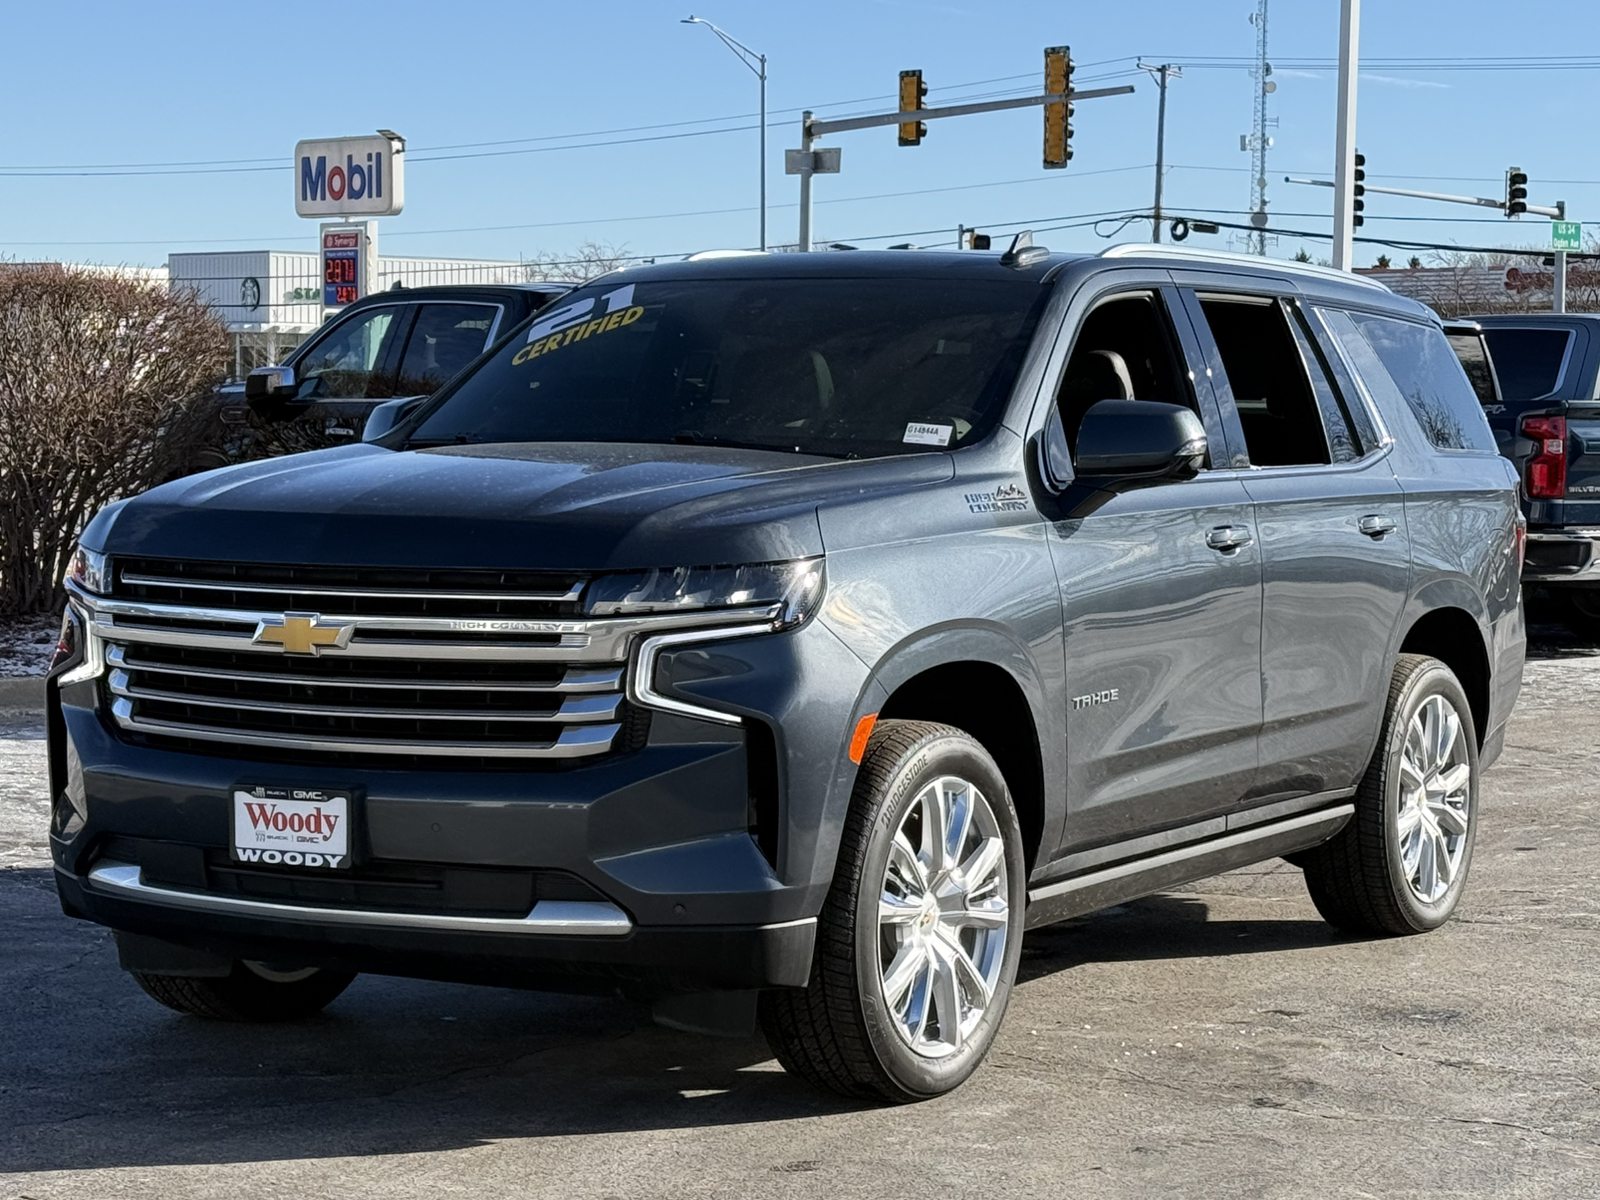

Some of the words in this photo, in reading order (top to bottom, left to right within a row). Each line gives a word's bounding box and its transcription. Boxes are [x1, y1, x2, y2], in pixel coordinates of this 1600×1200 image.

[301, 152, 382, 200] Mobil
[1558, 224, 1566, 234] US
[334, 235, 356, 247] Synergy
[1554, 238, 1569, 249] Ogden
[1570, 238, 1579, 248] Ave
[527, 283, 635, 344] 21
[512, 306, 644, 366] CERTIFIED
[969, 500, 1028, 513] COUNTRY
[451, 621, 487, 630] HIGH
[491, 622, 561, 631] COUNTRY
[1071, 688, 1119, 710] TAHOE
[293, 790, 322, 800] GMC
[880, 754, 929, 830] BRIDGESTONE
[243, 802, 340, 842] Woody
[296, 835, 320, 844] GMC
[236, 848, 343, 869] WOODY
